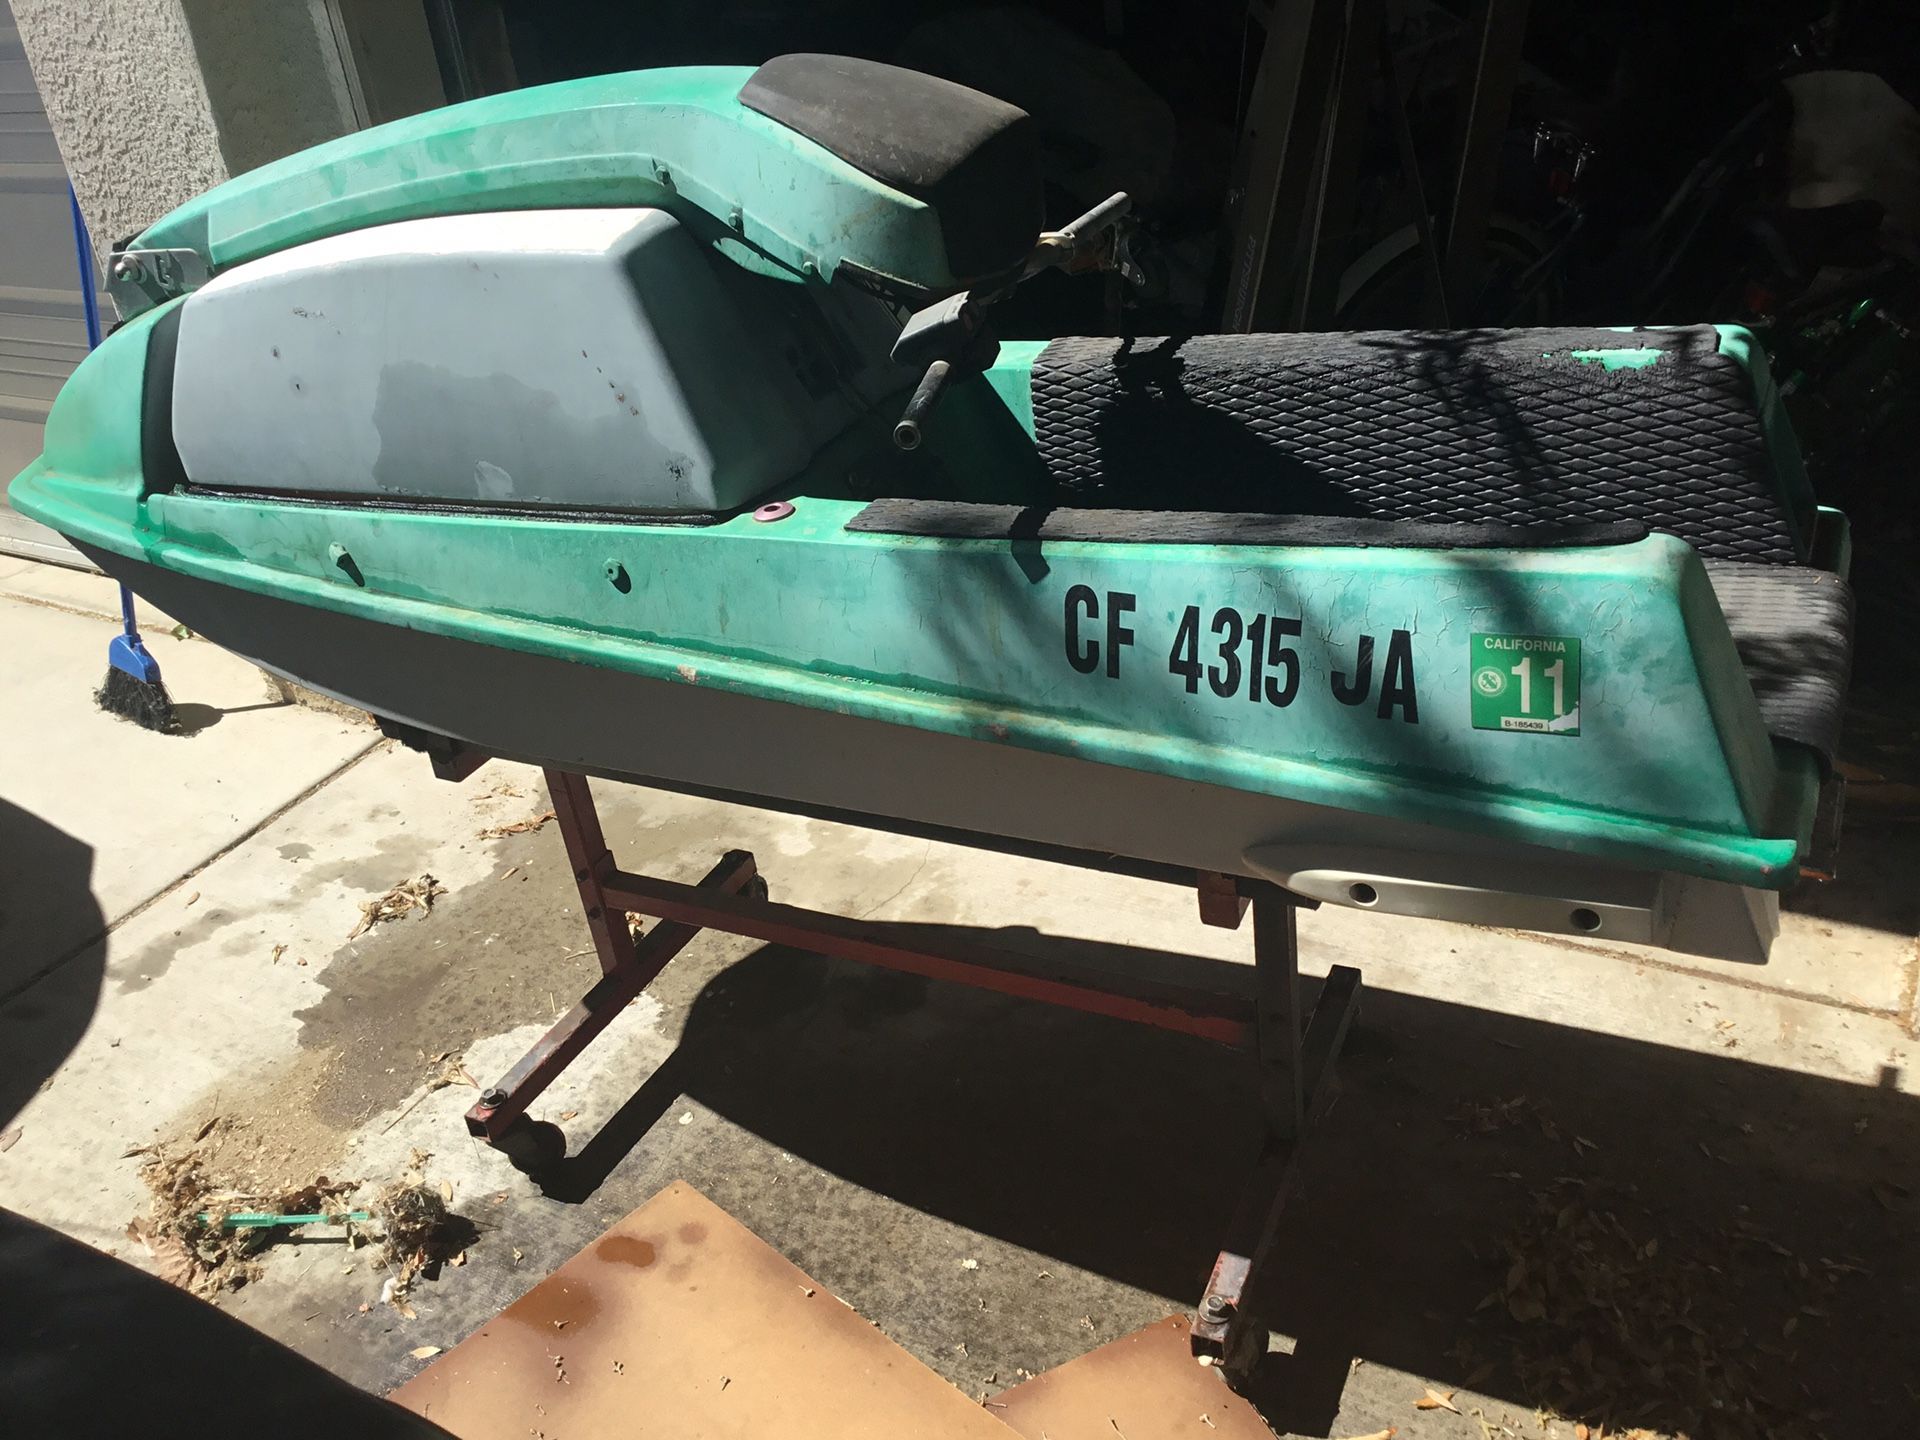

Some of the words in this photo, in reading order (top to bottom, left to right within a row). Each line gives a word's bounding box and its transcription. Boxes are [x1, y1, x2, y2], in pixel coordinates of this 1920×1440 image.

[1064, 584, 1136, 679] CF
[1168, 604, 1302, 708] 4315
[1331, 629, 1420, 724] JA
[1484, 638, 1566, 653] CALIFORNIA
[1511, 657, 1564, 716] 11
